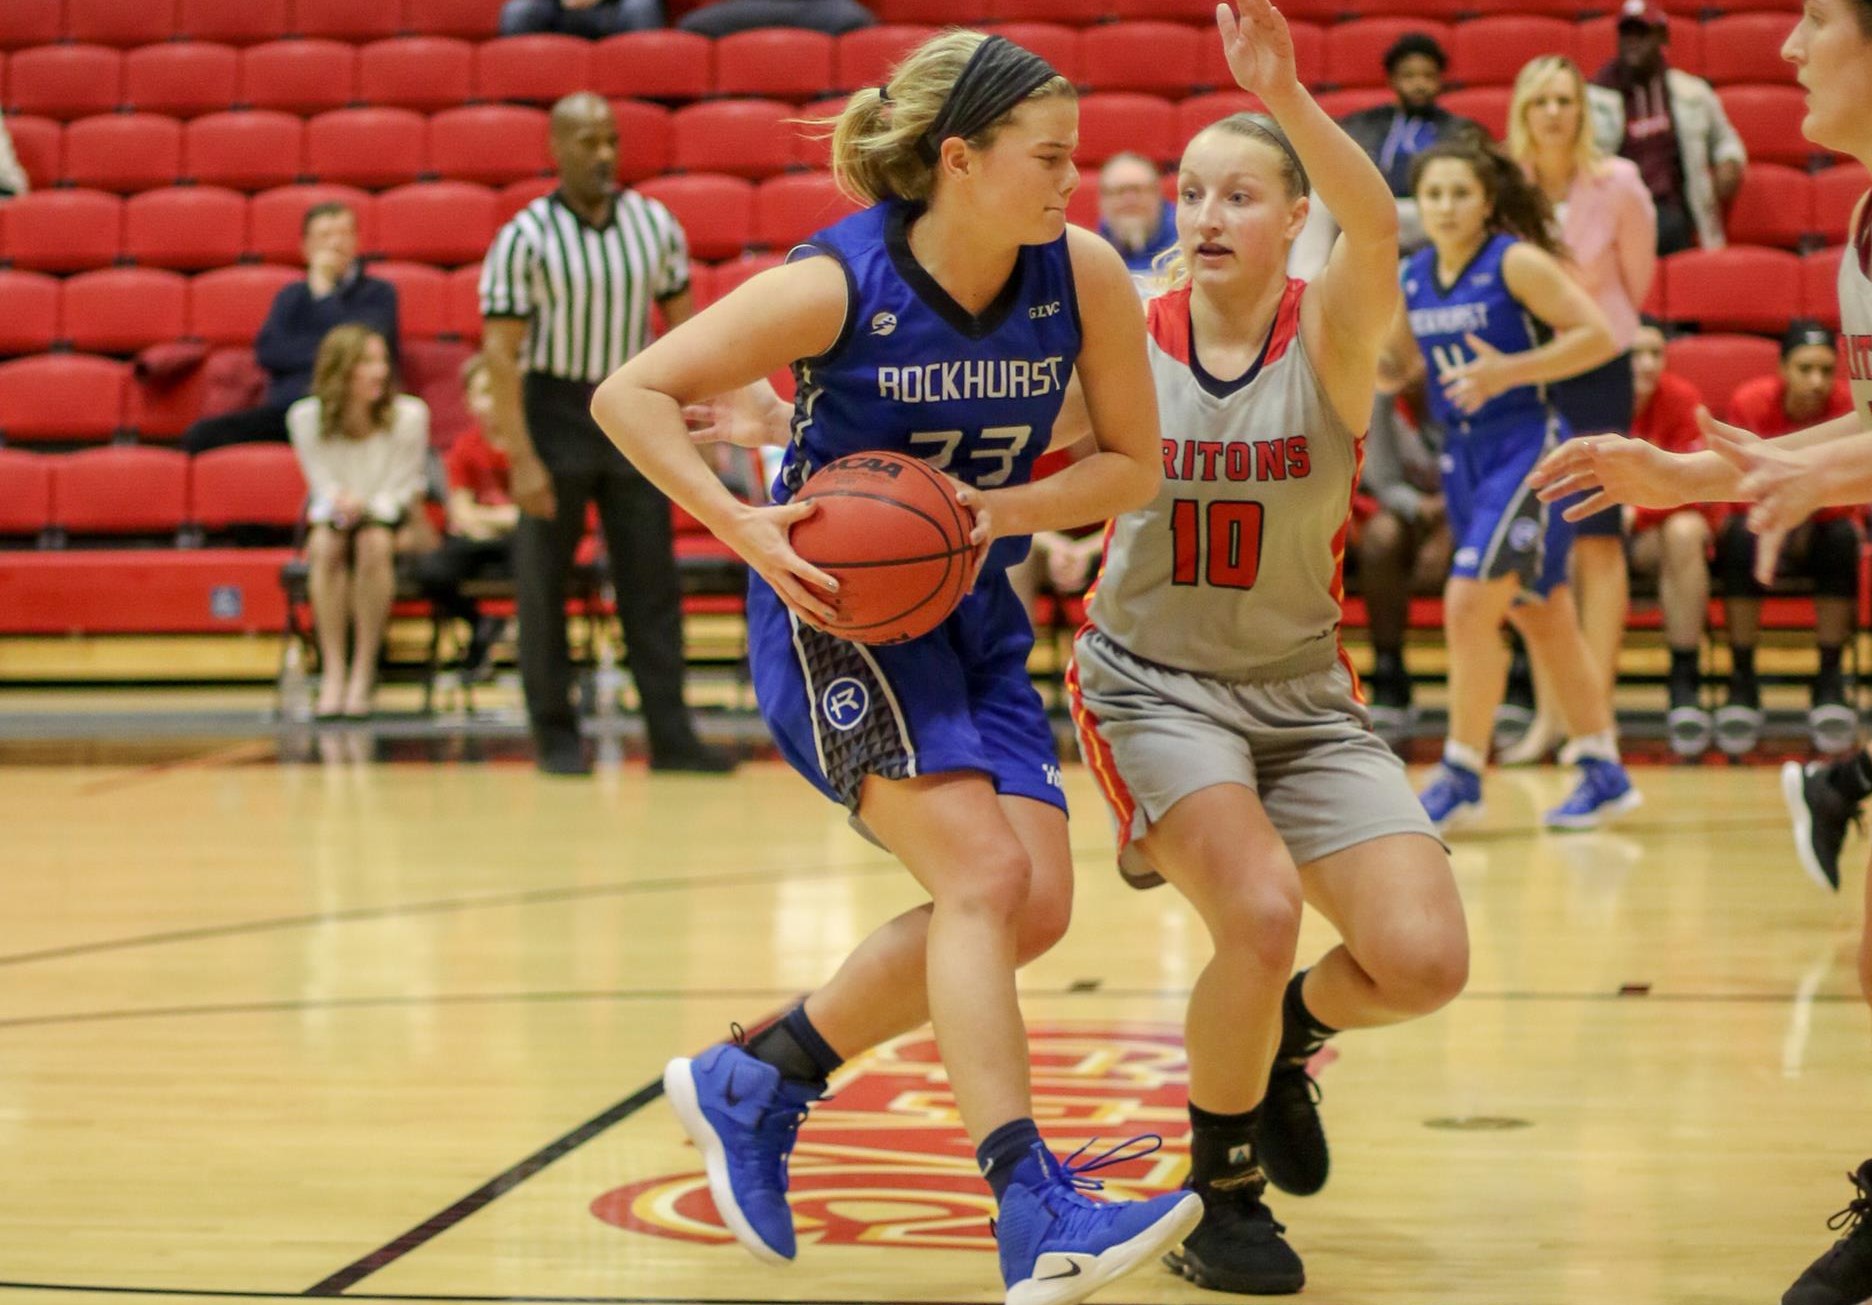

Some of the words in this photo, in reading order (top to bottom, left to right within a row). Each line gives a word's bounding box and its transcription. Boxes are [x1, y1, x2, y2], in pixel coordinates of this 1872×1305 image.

[1029, 301, 1060, 319] GLVC
[878, 357, 1062, 403] ROCKHURST
[1161, 435, 1311, 482] RITONS
[1169, 499, 1264, 591] 10
